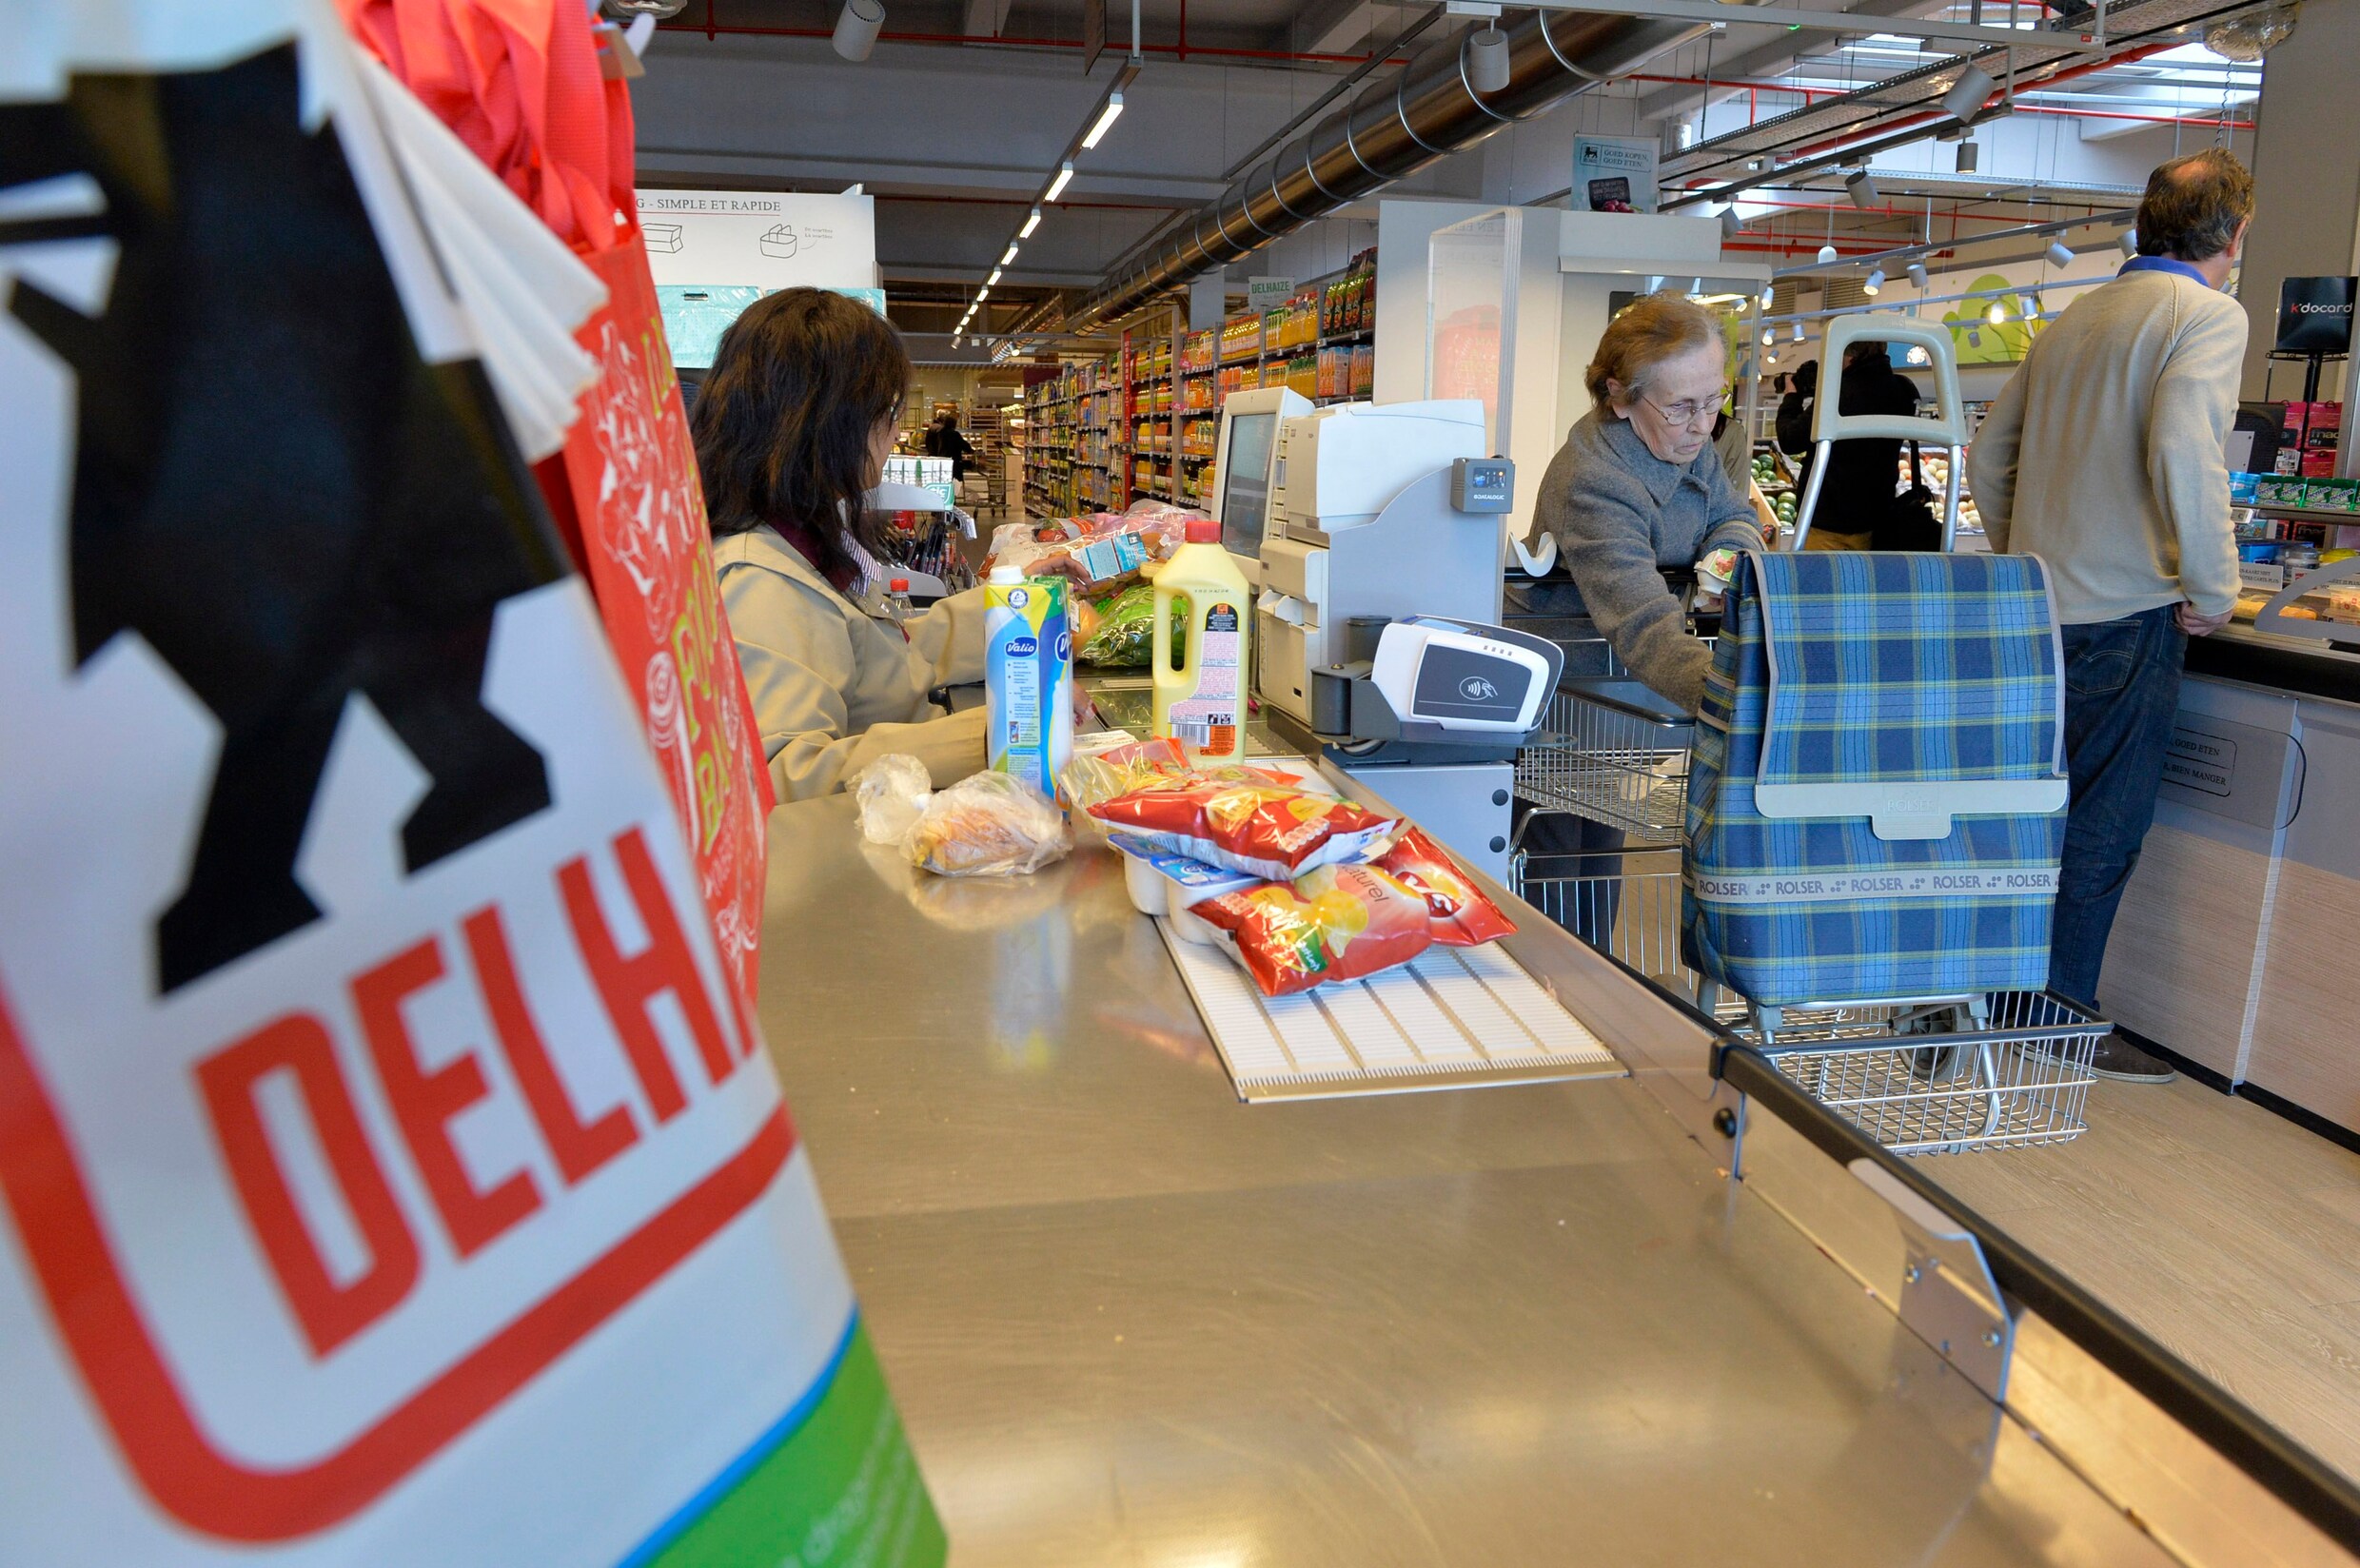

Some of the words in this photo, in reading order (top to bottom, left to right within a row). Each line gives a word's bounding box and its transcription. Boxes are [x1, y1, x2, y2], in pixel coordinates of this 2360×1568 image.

[1603, 149, 1623, 158] GOED
[1603, 157, 1622, 166] GOED
[657, 198, 706, 209] SIMPLE
[711, 200, 727, 210] ET
[731, 201, 781, 211] RAPIDE
[1251, 281, 1289, 294] DELHAIZE
[1007, 642, 1035, 653] Valio
[2174, 738, 2197, 751] GOED
[2197, 744, 2220, 755] ETEN
[2171, 764, 2191, 775] BIEN
[2192, 770, 2226, 786] MANGER
[1700, 879, 1748, 895] ROLSER
[1776, 880, 1824, 895] ROLSER
[1851, 877, 1903, 892] ROLSER
[1933, 875, 1981, 890] ROLSER
[2006, 873, 2051, 888] ROLSER
[190, 823, 757, 1366] DELH
